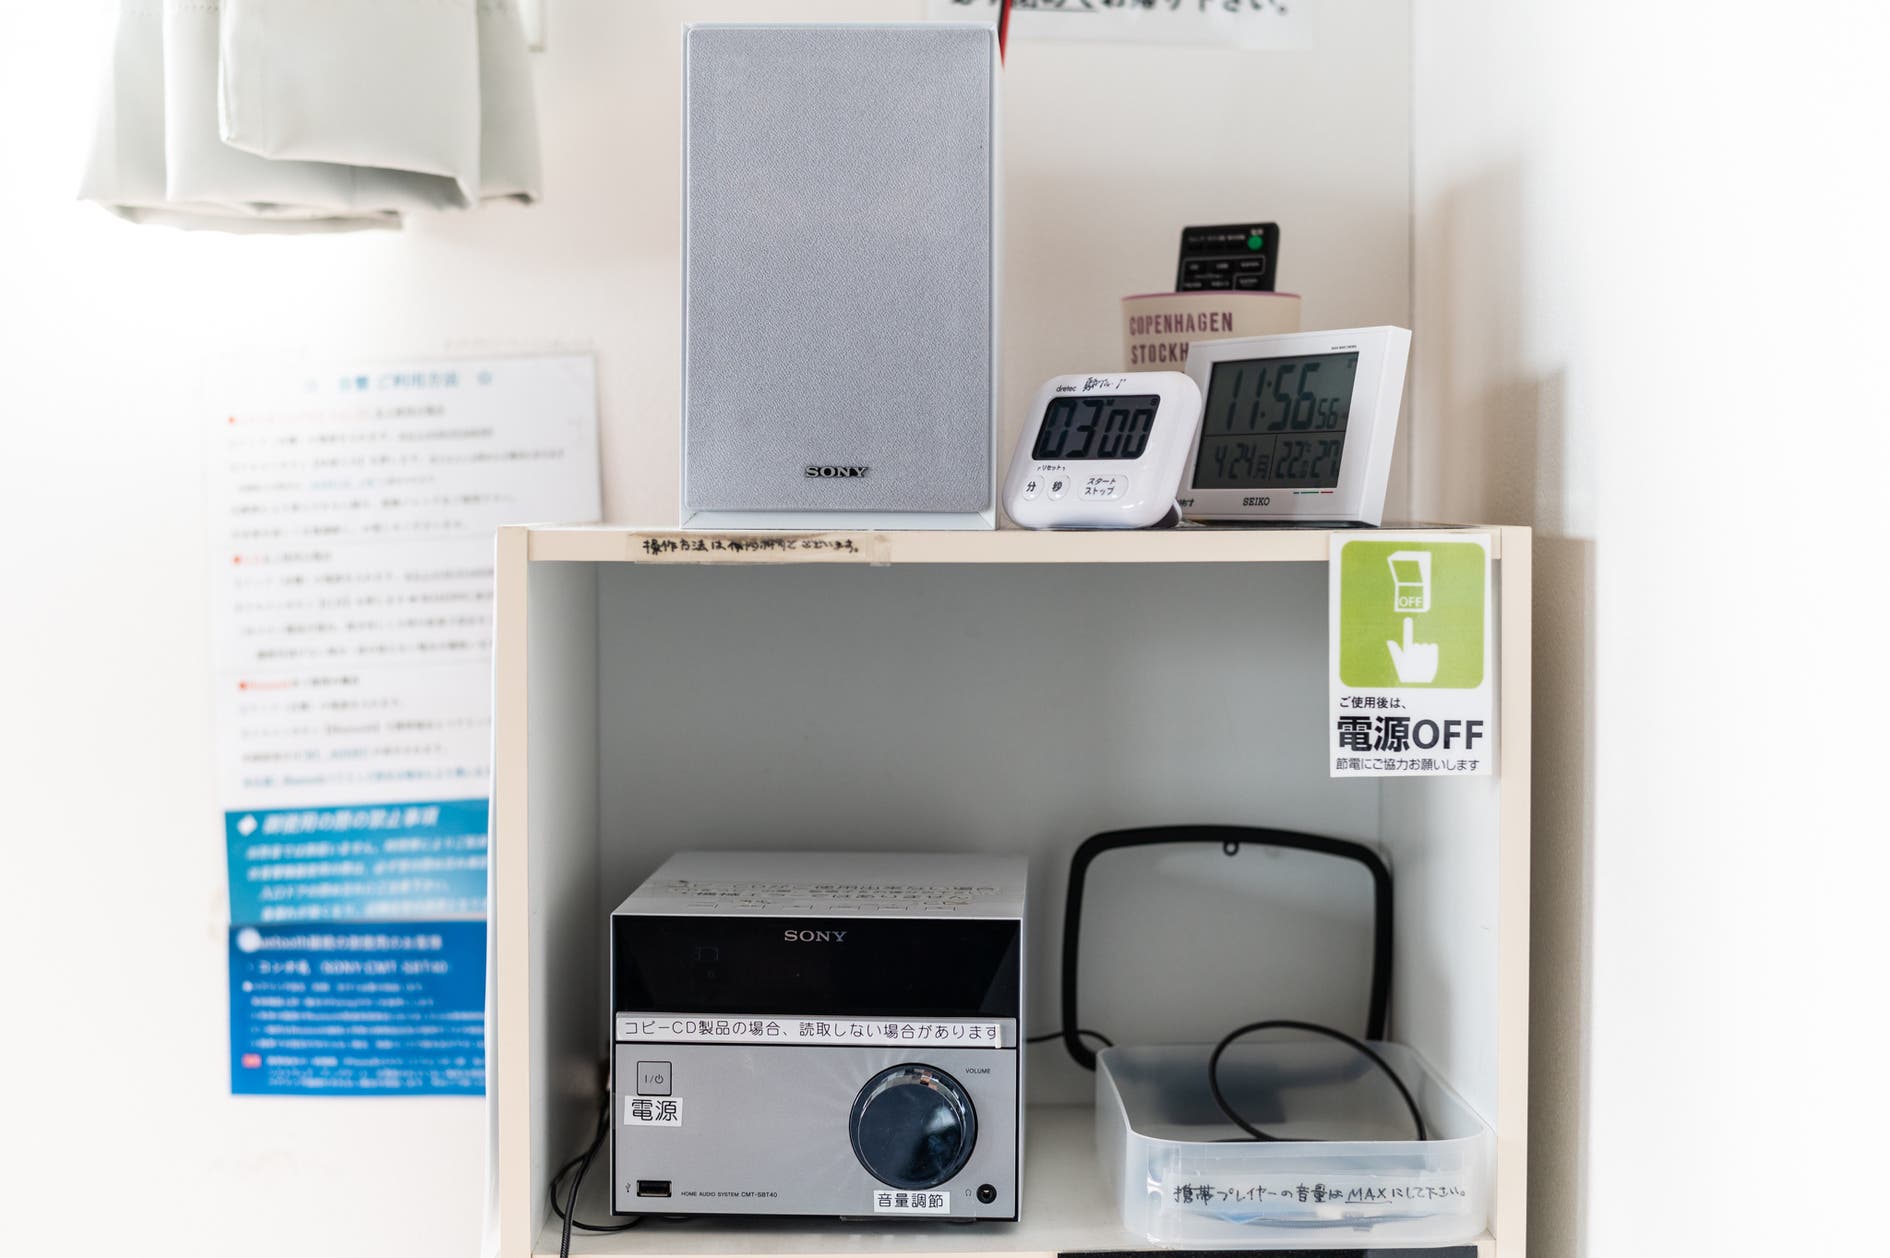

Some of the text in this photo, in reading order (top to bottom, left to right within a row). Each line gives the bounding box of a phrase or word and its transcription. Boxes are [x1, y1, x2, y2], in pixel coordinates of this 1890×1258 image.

[1129, 312, 1233, 336] COPENHAGEN
[1056, 384, 1077, 393] dretec
[1226, 362, 1340, 431] 11:56 56
[805, 465, 868, 478] SONY
[1026, 480, 1037, 493] 分
[1052, 480, 1063, 493] 秒
[1087, 477, 1117, 486] スタート
[1084, 487, 1115, 496] ストップ
[1242, 496, 1271, 507] SEIKO
[1398, 596, 1423, 608] OFF
[1340, 696, 1407, 709] ご使用後は、
[1337, 715, 1484, 753] 電源OFF
[1336, 757, 1480, 772] 節電にご協力お願いします
[783, 930, 848, 943] SONY
[965, 1067, 991, 1075] VOLUME
[631, 1099, 679, 1122] 電源
[876, 1193, 945, 1210] 音量調節
